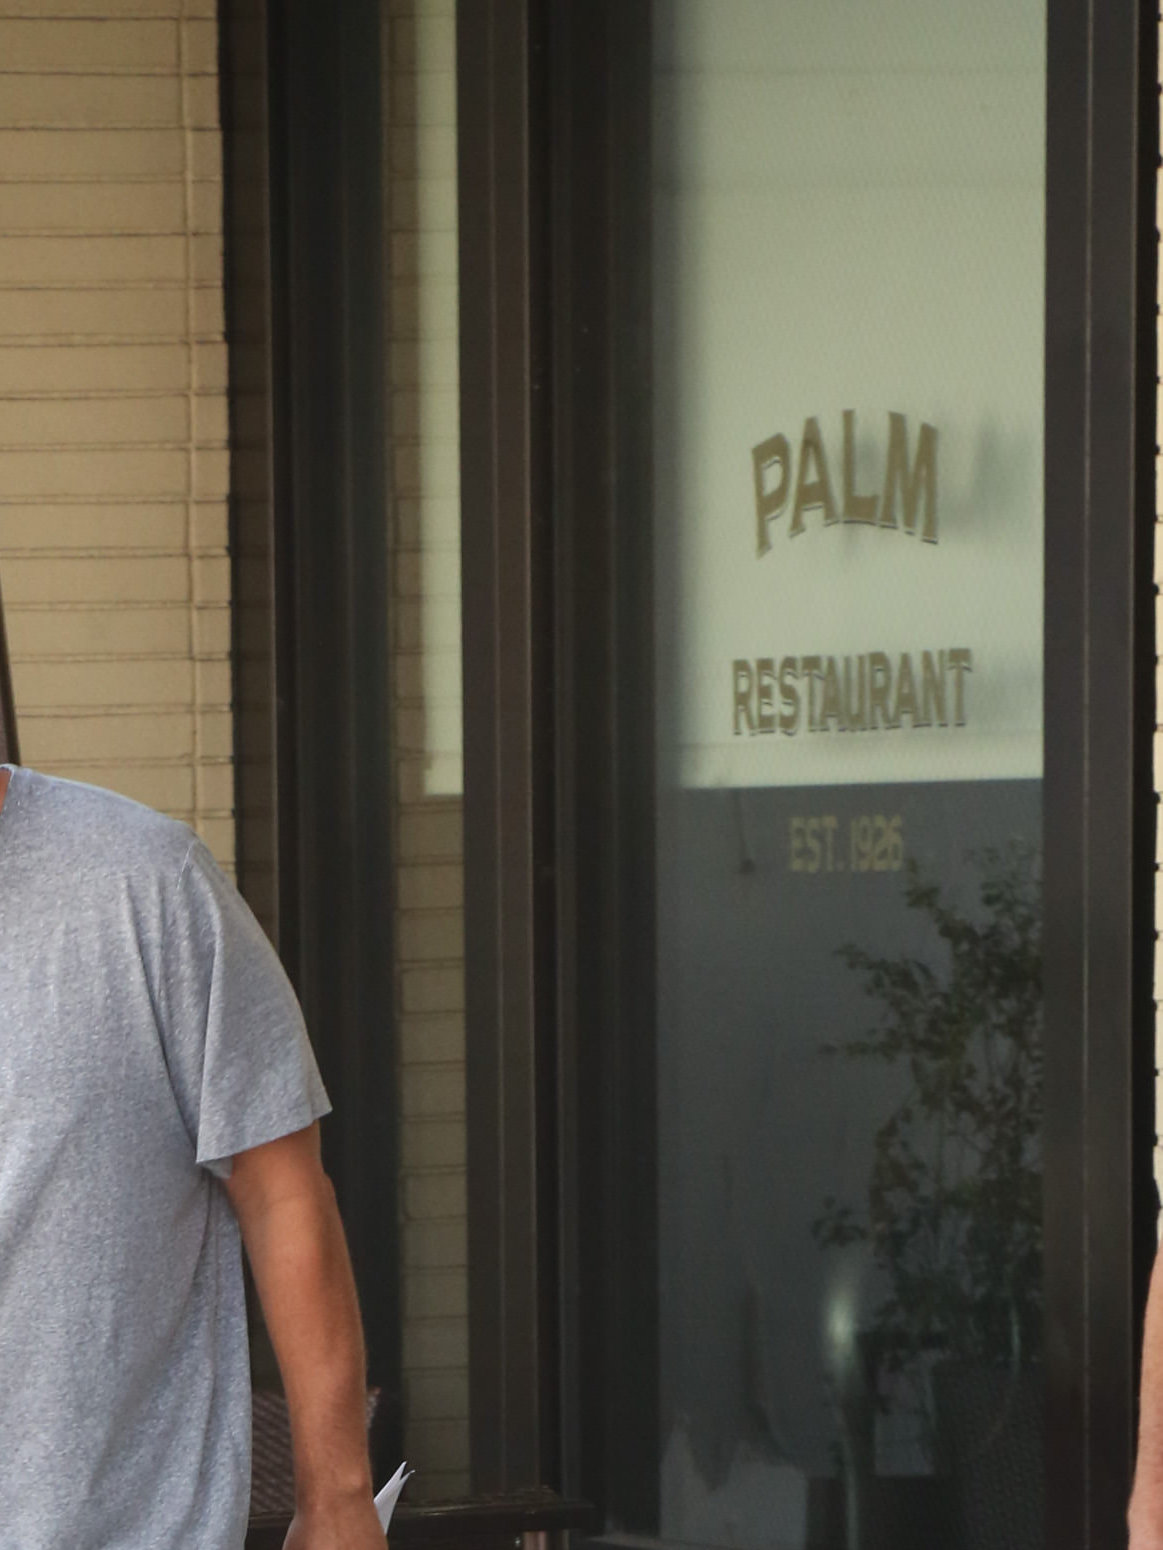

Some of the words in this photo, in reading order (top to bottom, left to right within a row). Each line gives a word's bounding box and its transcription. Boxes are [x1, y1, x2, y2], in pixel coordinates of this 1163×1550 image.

[750, 408, 939, 559] PALM
[732, 647, 973, 737] RESTAURANT
[850, 815, 904, 872] 1926
